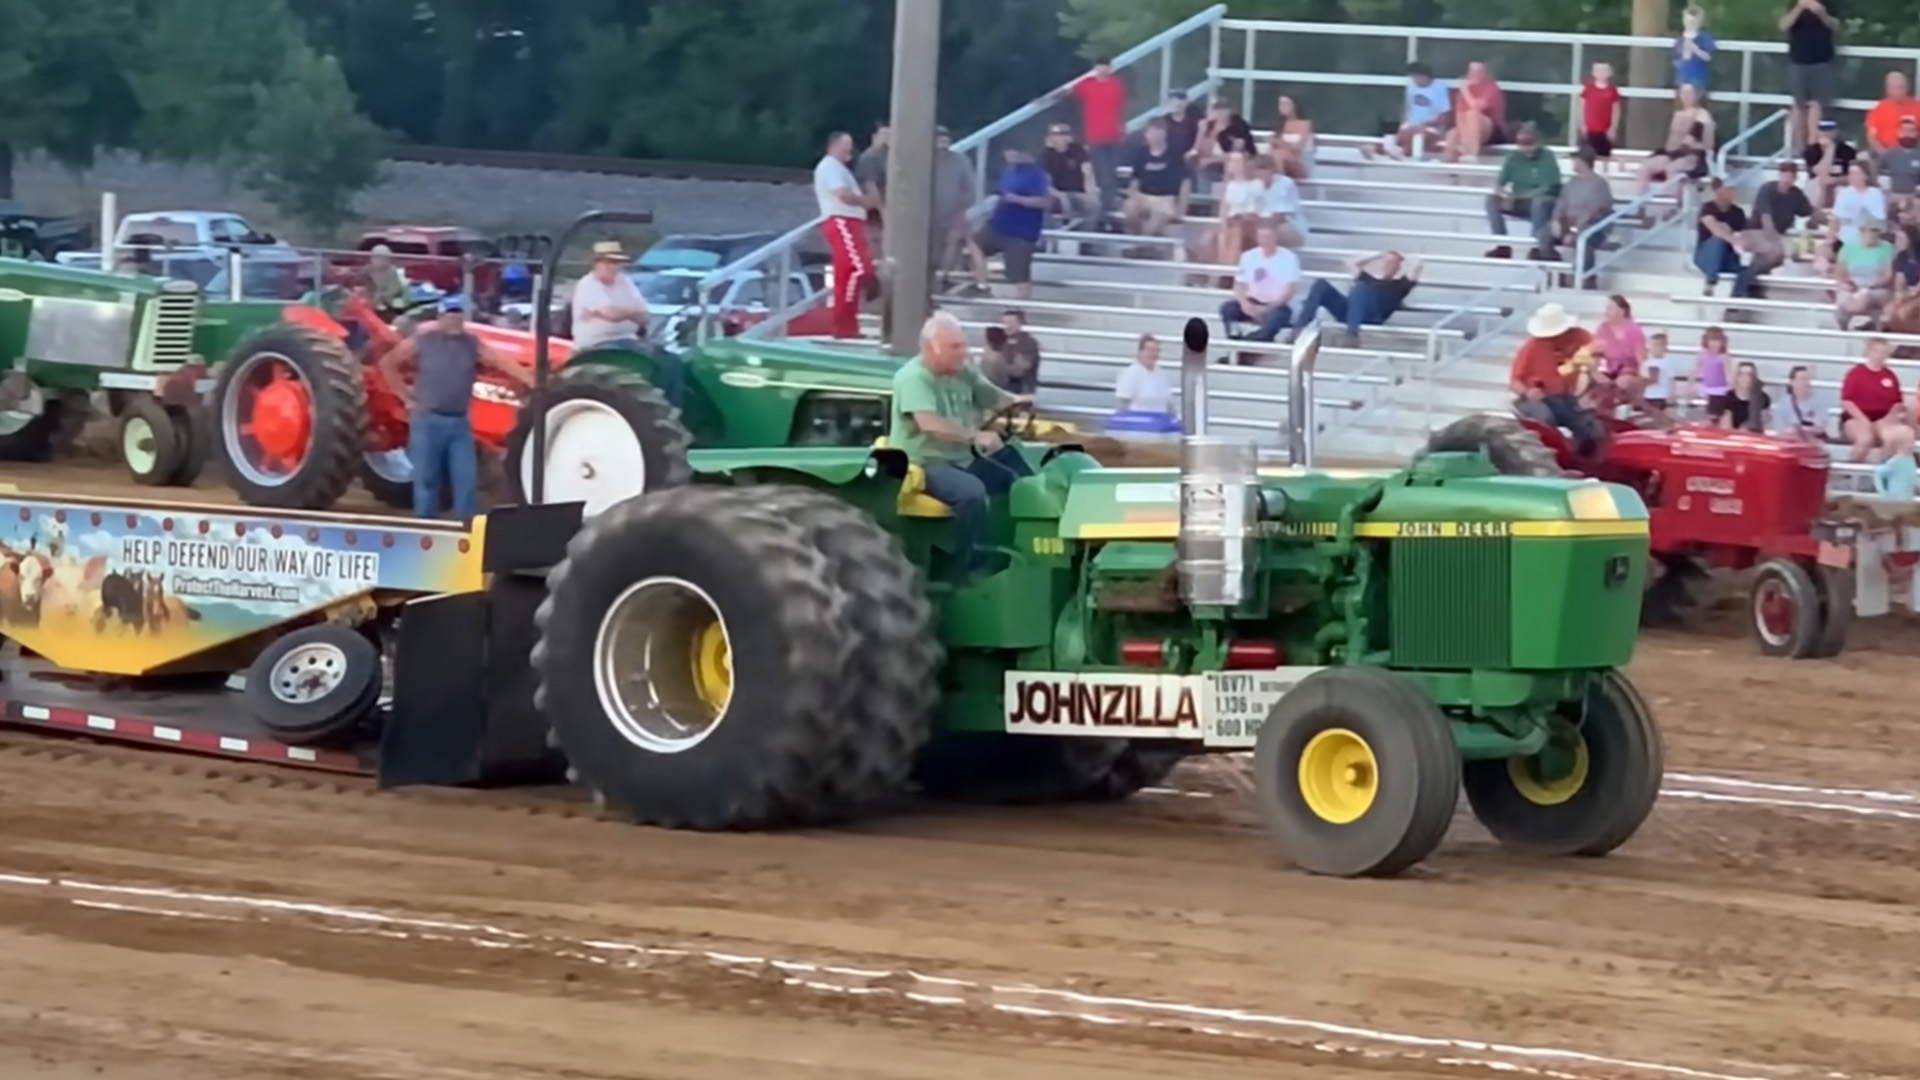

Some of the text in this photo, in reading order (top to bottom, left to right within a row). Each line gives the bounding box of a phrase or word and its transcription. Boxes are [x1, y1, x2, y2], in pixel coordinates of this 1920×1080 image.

[1397, 522, 1514, 537] JOHN DEERE
[122, 539, 377, 581] HELP DEFEND OUR WAY OF LIFE!
[1010, 680, 1200, 729] JOHNZILLA
